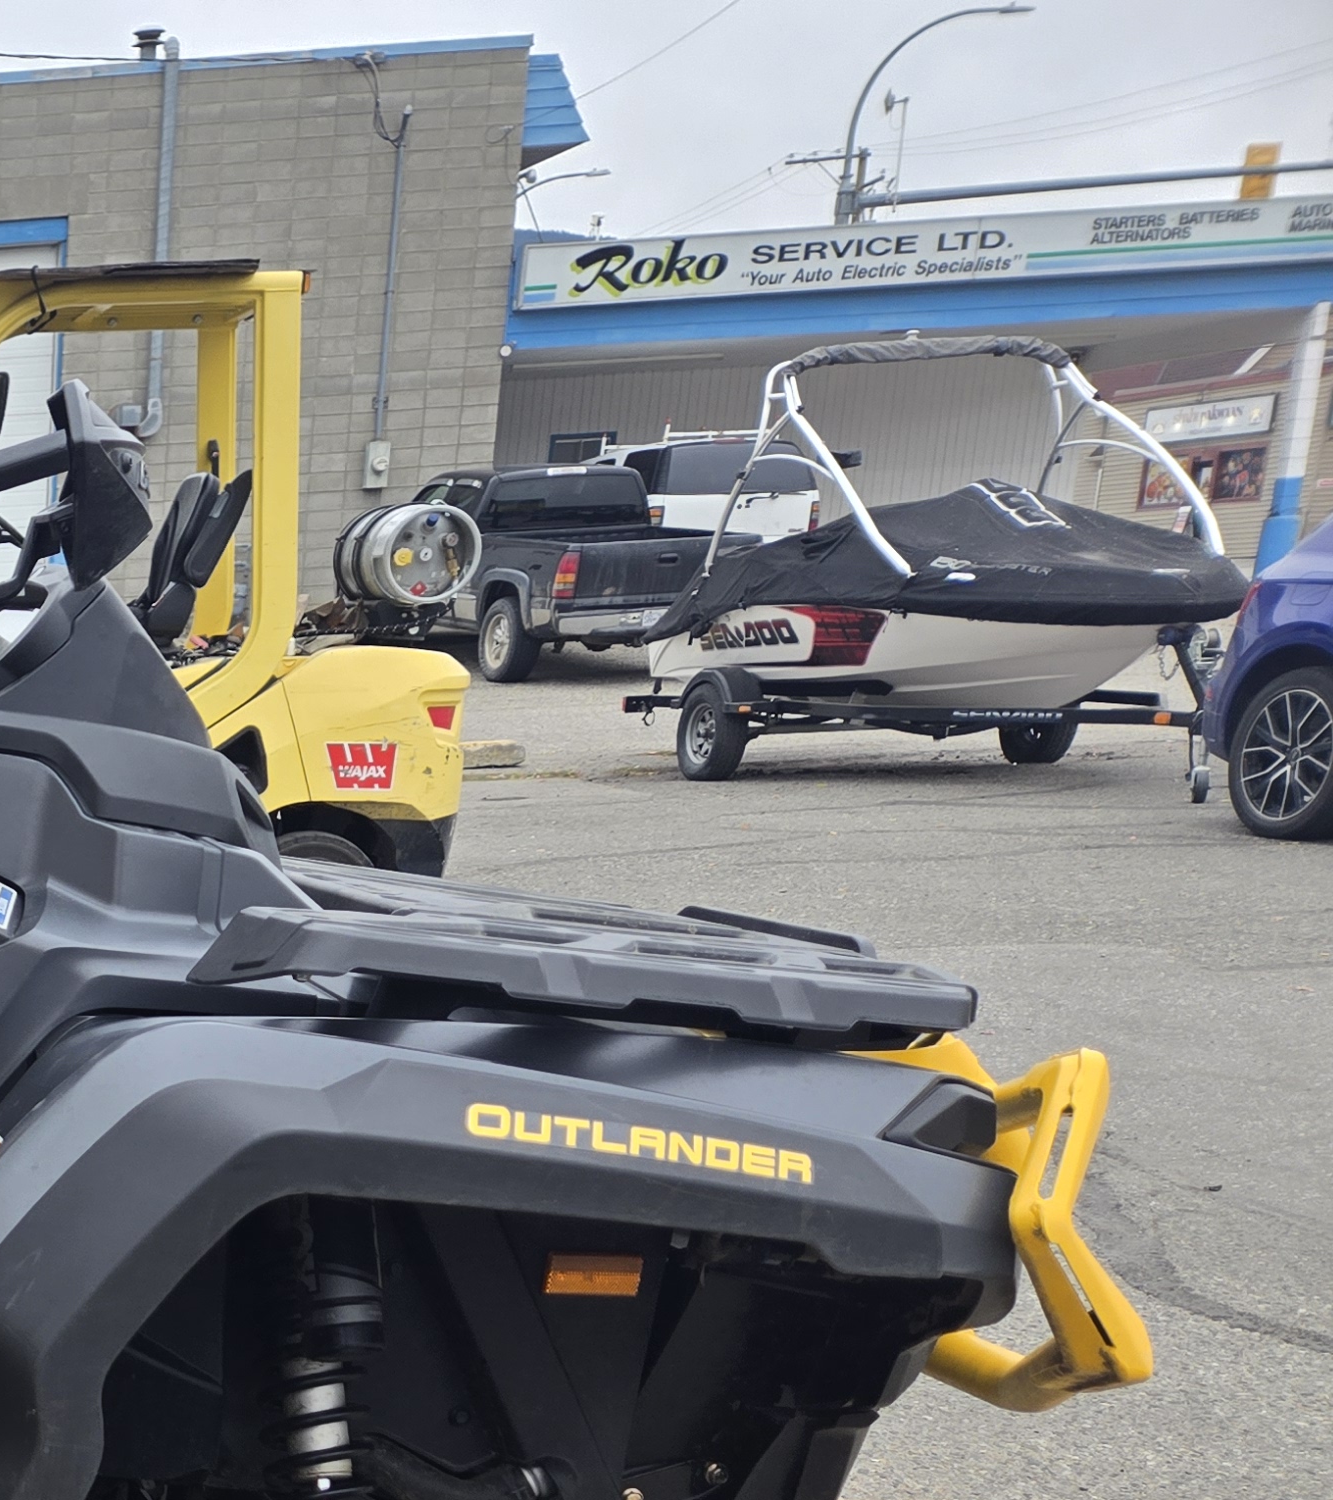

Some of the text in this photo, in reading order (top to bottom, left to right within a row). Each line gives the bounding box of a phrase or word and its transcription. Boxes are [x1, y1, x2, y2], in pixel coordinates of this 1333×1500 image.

[1092, 207, 1261, 231] STARTERS BATTERIES
[1090, 226, 1192, 245] ALTERNATORS
[569, 229, 1014, 297] Roko SERVICE LTD.
[792, 267, 833, 284] Auto
[841, 261, 907, 281] Electric
[338, 765, 387, 781] WAJAX
